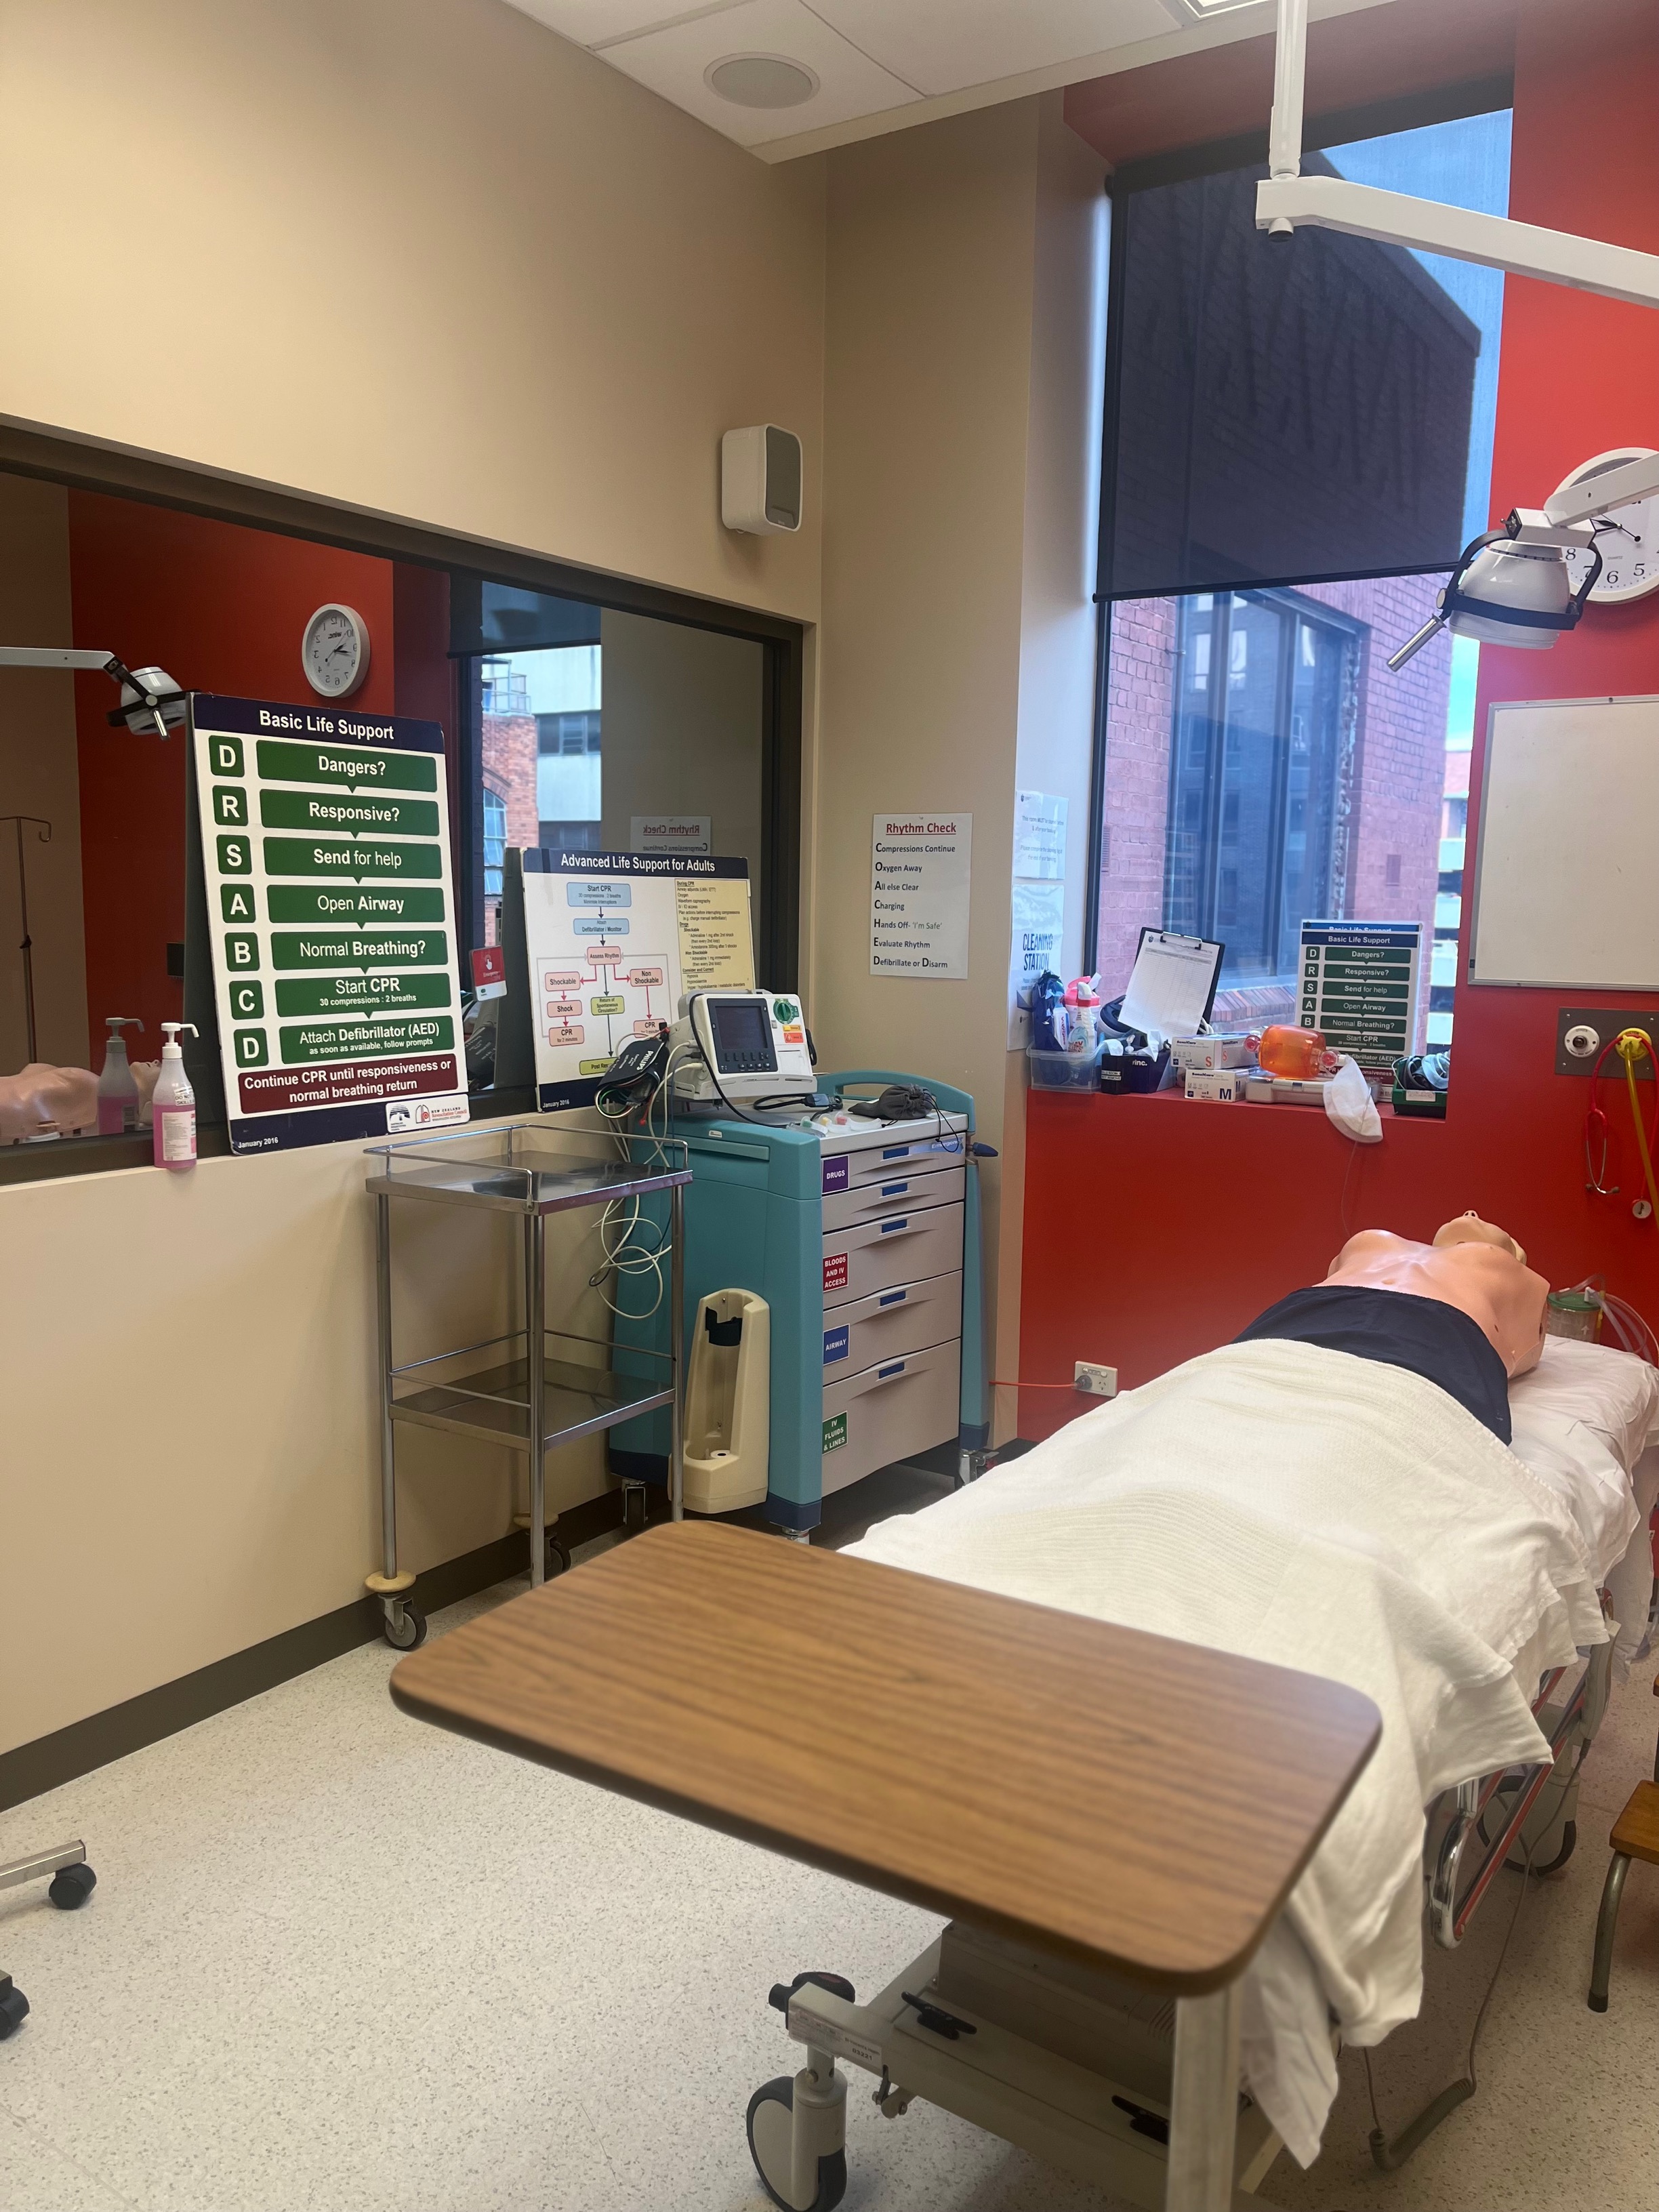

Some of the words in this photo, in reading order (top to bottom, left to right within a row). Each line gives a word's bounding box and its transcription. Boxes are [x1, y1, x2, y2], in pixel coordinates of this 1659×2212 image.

[1565, 548, 1576, 560] 8
[1633, 563, 1645, 576] 5
[1607, 571, 1618, 583] 6
[260, 710, 302, 730] Basic
[307, 716, 334, 733] Life
[338, 719, 394, 740] Support
[220, 745, 236, 767] D
[319, 756, 386, 777] Dangers?
[222, 796, 240, 817] R
[309, 802, 399, 822] Responsive?
[886, 823, 924, 834] Rhythm
[927, 822, 956, 833] Check
[876, 843, 923, 854] Compressions
[227, 844, 243, 866] S
[314, 849, 350, 864] Send
[354, 852, 371, 865] for
[375, 853, 401, 868] help
[561, 854, 610, 867] Advanced
[613, 856, 630, 869] Life
[633, 857, 670, 872] Support
[672, 859, 684, 870] for
[687, 859, 715, 872] Adults
[875, 862, 902, 873] Oxygen
[903, 865, 922, 873] Away
[875, 881, 885, 890] All
[230, 894, 248, 915] A
[318, 895, 354, 913] Open
[358, 896, 404, 914] Airway
[874, 900, 905, 911] Charging
[874, 918, 896, 928] Hands
[874, 937, 903, 947] Evaluate
[905, 941, 930, 949] Rhythm
[1023, 933, 1053, 951] CLEANING
[235, 942, 251, 964] B
[300, 942, 348, 957] Normal
[353, 941, 426, 958] Breathing?
[874, 956, 911, 966] Defibrillate
[922, 958, 947, 968] Disarm
[1023, 954, 1050, 971] STATION
[335, 980, 367, 995] Start
[370, 978, 400, 991] CPR
[1307, 983, 1313, 991] S
[239, 989, 255, 1012] C
[320, 998, 329, 1006] 30
[330, 996, 380, 1006] compressions
[392, 994, 417, 1003] breaths
[1343, 1003, 1361, 1011] Open
[1362, 1004, 1386, 1012] Airway
[1357, 1021, 1395, 1029] Breathing?
[300, 1030, 335, 1044] Attach
[339, 1027, 405, 1041] Defibrillator
[409, 1023, 439, 1038] (AED)
[243, 1037, 260, 1059] D
[320, 1046, 338, 1054] soon
[350, 1042, 383, 1050] available,
[384, 1040, 404, 1048] follow
[407, 1038, 433, 1048] prompts
[637, 1050, 653, 1071] PHILIPS
[1206, 1056, 1212, 1067] S
[1223, 1050, 1227, 1061] S
[244, 1075, 299, 1089] Continue
[302, 1070, 327, 1084] CPR
[330, 1067, 354, 1081] until
[357, 1062, 438, 1079] responsiveness
[441, 1061, 451, 1069] or
[289, 1087, 329, 1103] normal
[332, 1083, 384, 1098] breathing
[386, 1080, 417, 1094] return
[1235, 1081, 1240, 1092] M
[1220, 1088, 1231, 1100] M
[238, 1139, 262, 1148] January
[827, 1170, 845, 1179] DRUGS
[825, 1256, 846, 1267] BLOODS
[826, 1269, 838, 1277] AND
[825, 1277, 846, 1288] ACCESS
[825, 1338, 846, 1351] AIRWAY
[832, 1419, 838, 1427] IV
[825, 1427, 844, 1440] FLUIDS
[830, 1437, 845, 1449] LINES
